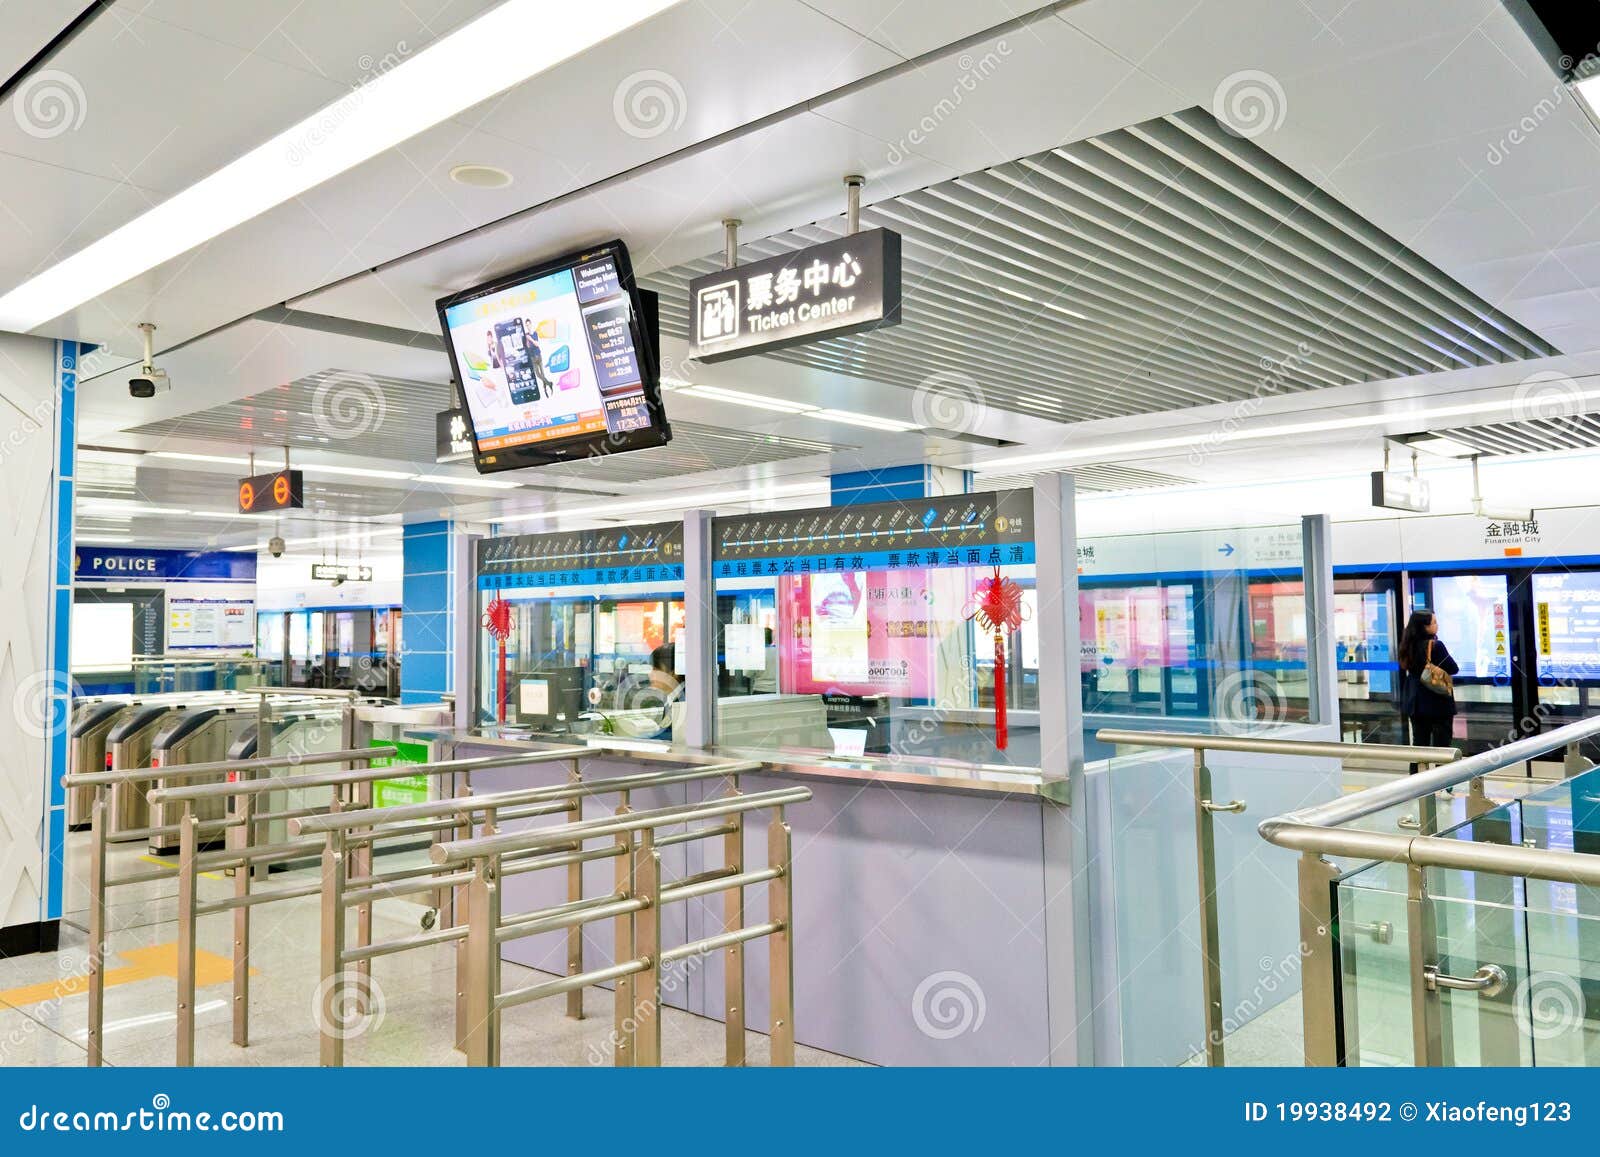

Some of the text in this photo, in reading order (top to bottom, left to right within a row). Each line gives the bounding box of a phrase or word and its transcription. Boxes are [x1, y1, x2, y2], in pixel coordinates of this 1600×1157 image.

[747, 252, 862, 310] 票务中心
[748, 296, 855, 333] Ticket Center
[1485, 520, 1539, 537] 金融城
[93, 558, 156, 571] POLICE
